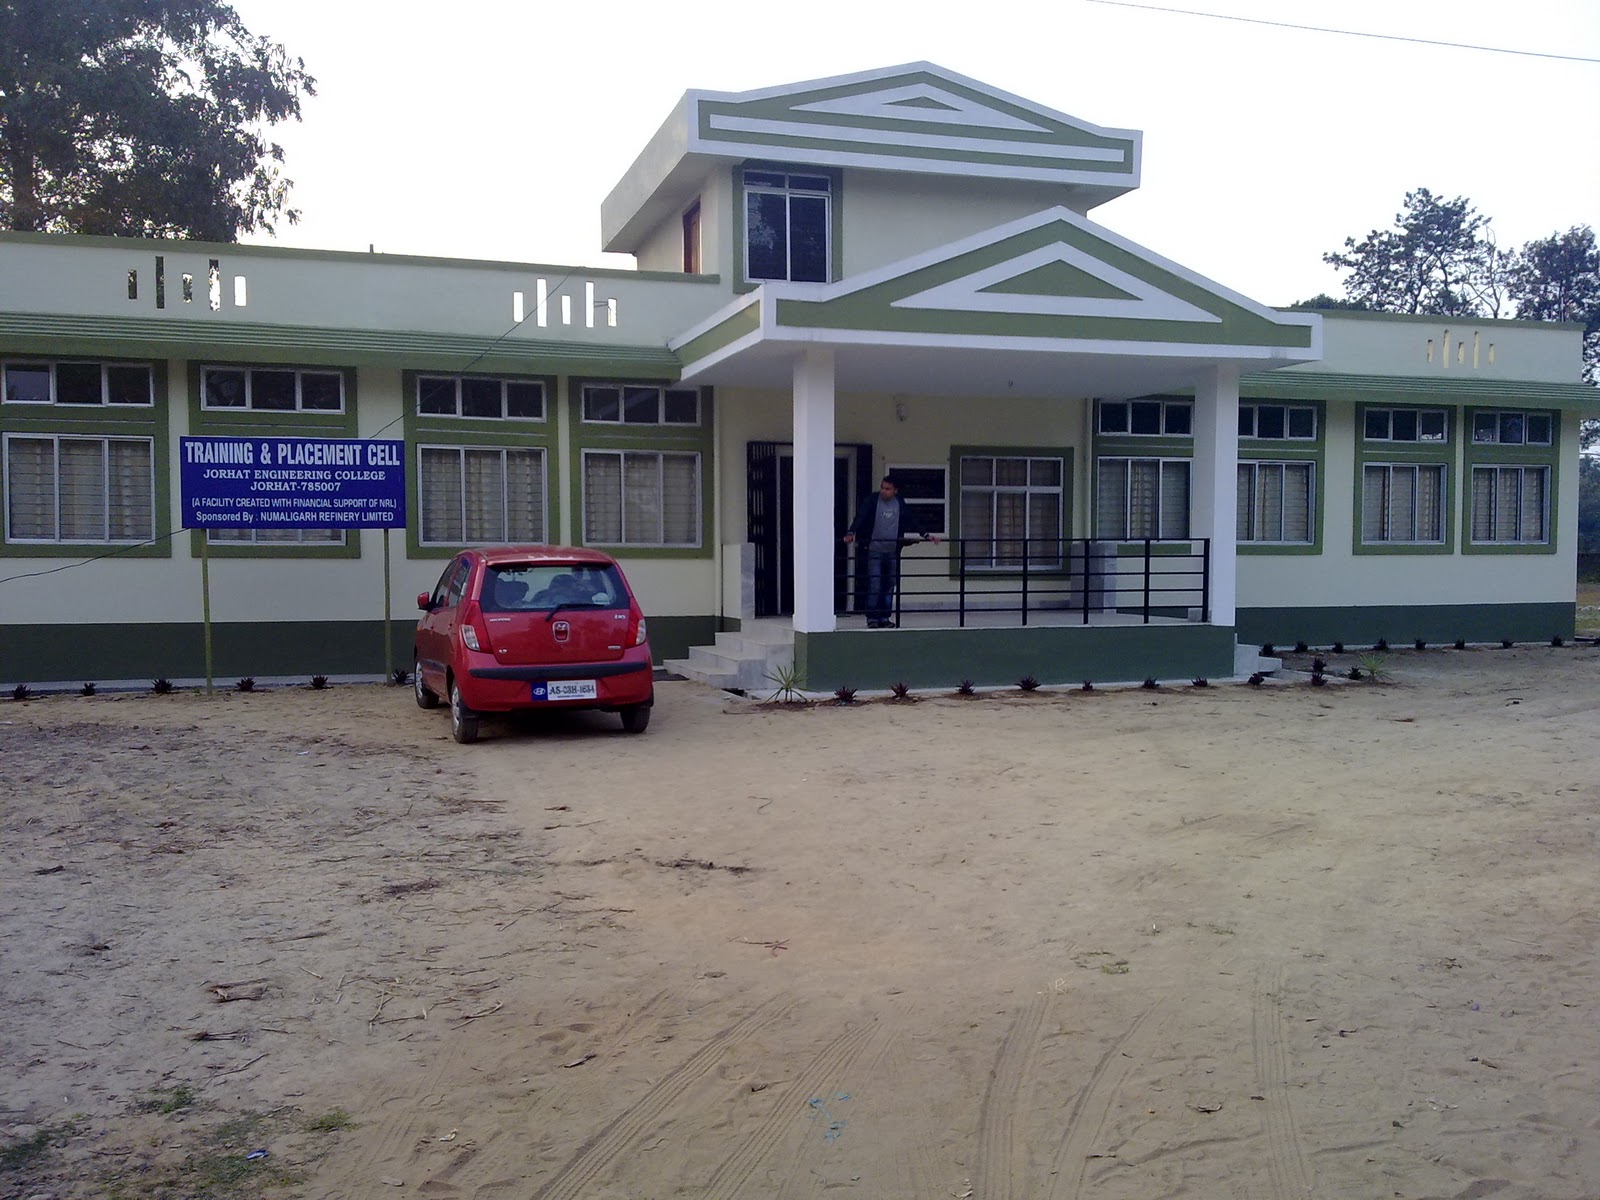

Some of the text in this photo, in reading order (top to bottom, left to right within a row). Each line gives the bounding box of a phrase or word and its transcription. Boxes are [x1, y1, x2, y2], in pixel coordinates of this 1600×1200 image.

[185, 441, 400, 466] TRAINING & PLACEMENT CELL
[203, 469, 386, 480] JORHAT ENGINEERING COLLEGE
[250, 481, 341, 491] JORHAT-785007
[202, 497, 235, 507] FACILITY
[235, 498, 271, 507] CREATED
[271, 498, 292, 507] WITH
[293, 498, 333, 508] FINANCIAL
[333, 498, 368, 508] SUPPORT
[368, 498, 379, 508] OF
[379, 498, 397, 508] NRL)
[196, 511, 241, 523] Sponsored
[242, 511, 254, 523] By
[260, 511, 317, 522] NUMALIGARH
[319, 511, 360, 522] REFINERY
[361, 511, 394, 522] LIMITED
